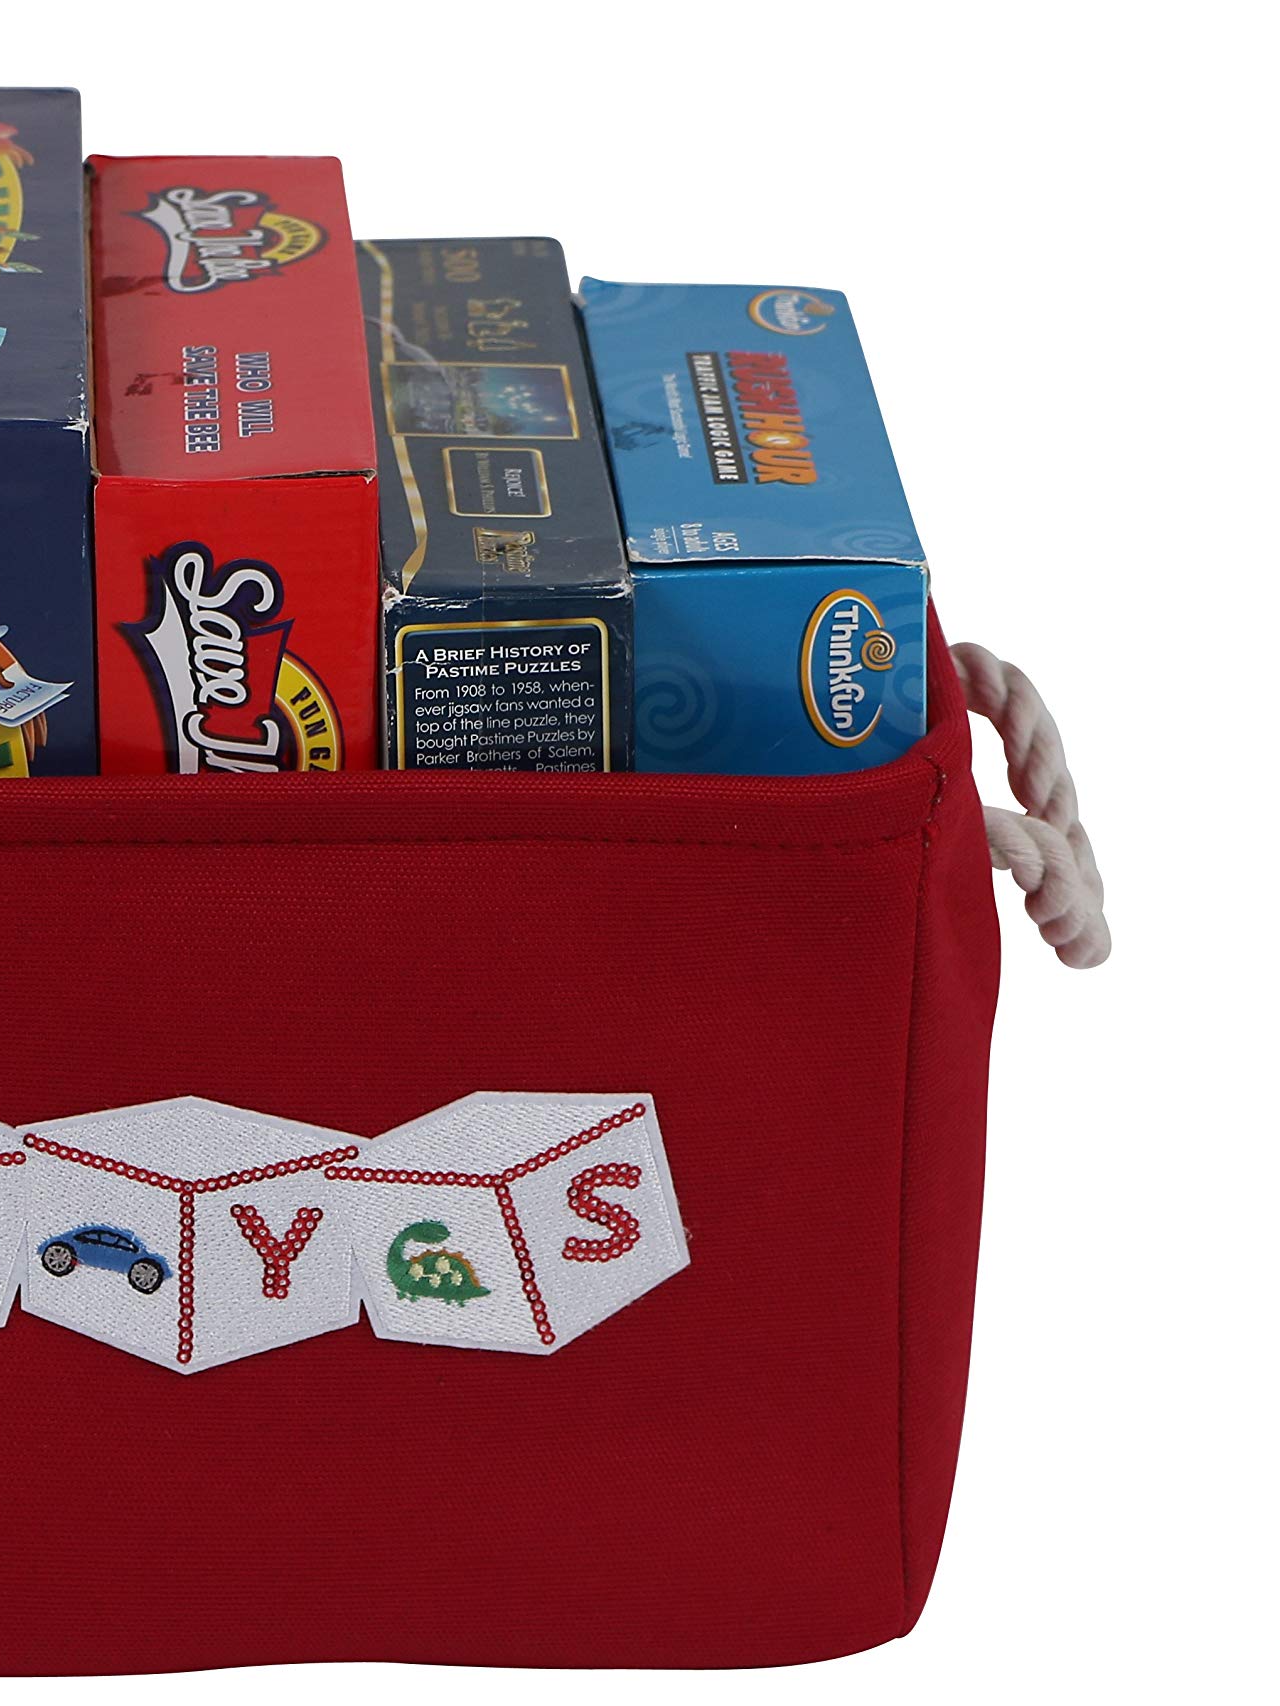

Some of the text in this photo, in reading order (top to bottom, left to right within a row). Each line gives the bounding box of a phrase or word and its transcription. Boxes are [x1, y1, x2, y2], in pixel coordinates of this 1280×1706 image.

[182, 346, 221, 454] SAVE THE BEE
[234, 352, 274, 438] WHO WILL
[691, 355, 740, 481] TRAFFIC JAM LOGIC GAME
[712, 532, 740, 552] AGES
[174, 552, 275, 706] Save
[415, 643, 591, 663] A BRIEF HISTORY OF
[426, 660, 582, 679] PASTIME PUZZLES
[414, 679, 595, 700] From 1908 to 1958, when-
[290, 686, 328, 738] FUN
[414, 696, 595, 718] ever jigsaw fans wanted a
[415, 712, 596, 735] top of the line puzzle, they
[416, 728, 596, 750] bought Pastime Puzzles by
[416, 745, 596, 766] Parker Brothers of Salem,
